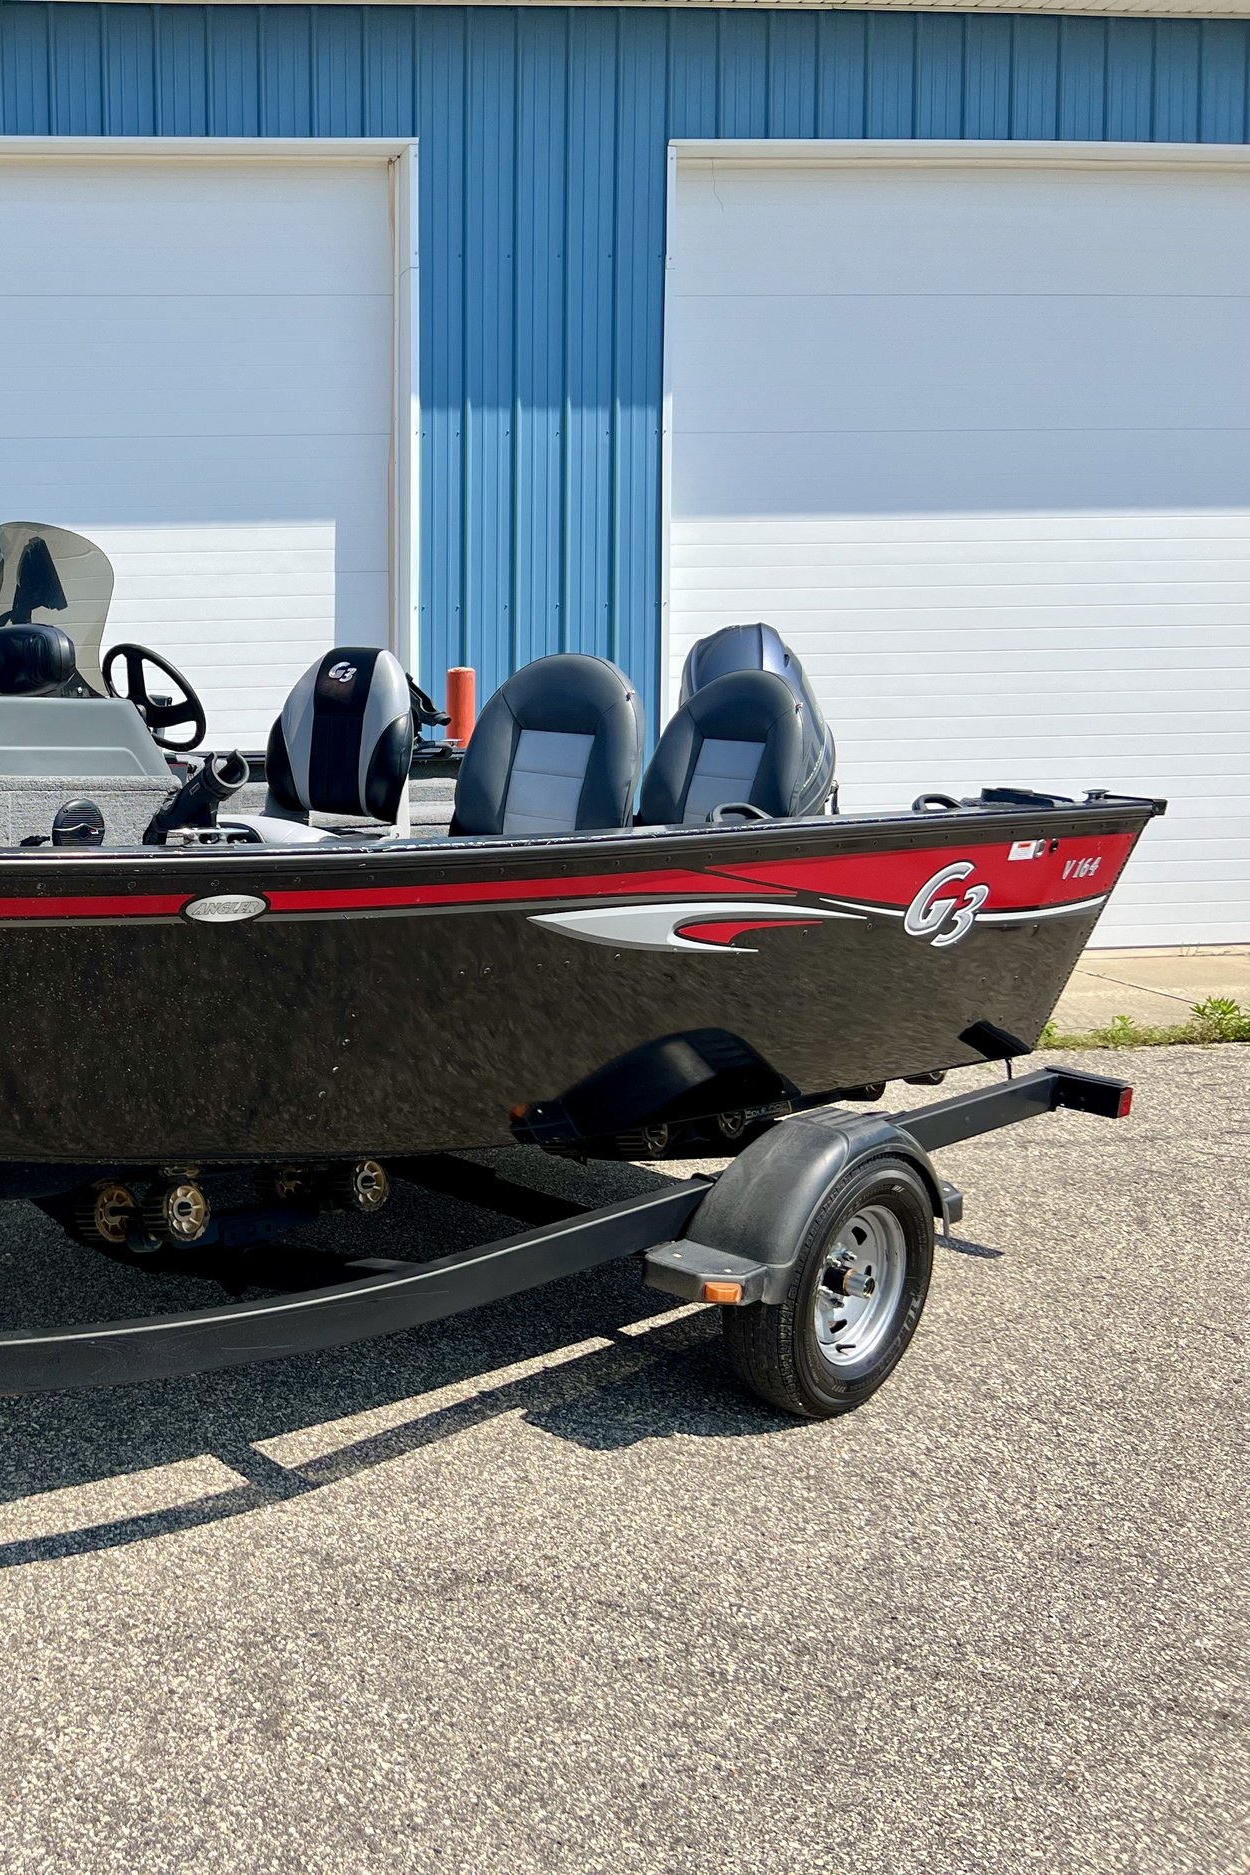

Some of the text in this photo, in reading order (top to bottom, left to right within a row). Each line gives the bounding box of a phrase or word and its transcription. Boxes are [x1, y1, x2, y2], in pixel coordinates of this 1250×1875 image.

[329, 661, 357, 683] G3
[192, 901, 259, 915] ANGLER
[904, 861, 990, 947] G3
